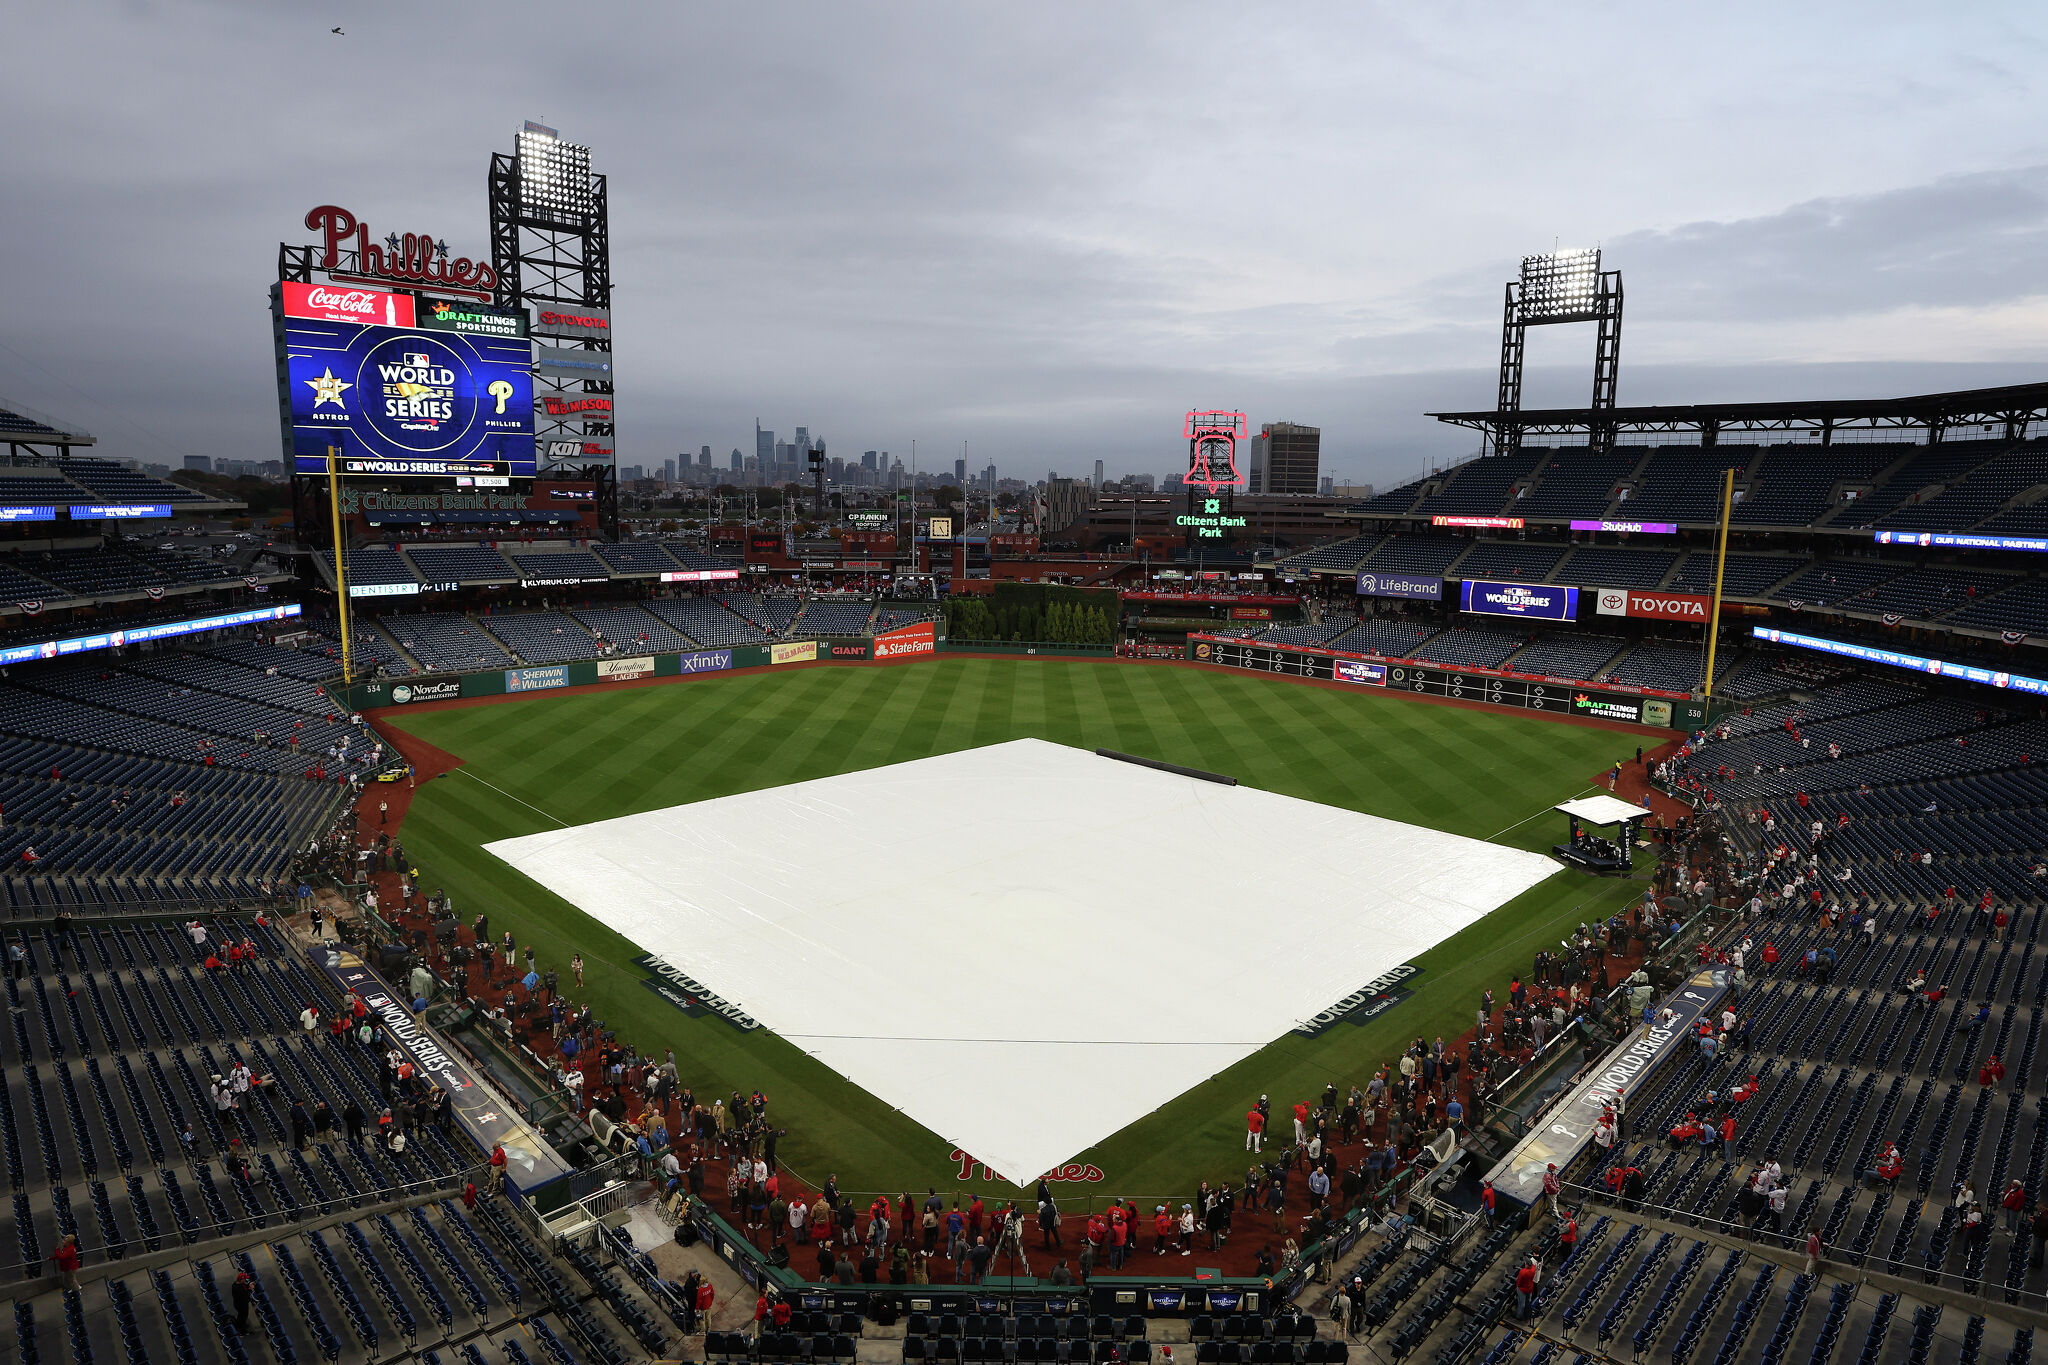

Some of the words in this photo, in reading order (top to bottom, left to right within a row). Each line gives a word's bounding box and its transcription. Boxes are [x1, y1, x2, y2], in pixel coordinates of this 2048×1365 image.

[305, 205, 498, 289] Phillies
[307, 288, 376, 314] Coca-Cola
[456, 322, 516, 334] SPORTSBOOK
[558, 314, 608, 330] TOYOTA
[378, 364, 455, 386] WORLD
[386, 399, 452, 420] SERIES
[312, 413, 350, 421] ASTROS
[548, 442, 582, 456] KDI
[363, 461, 409, 472] WORLD
[410, 462, 447, 472] SERIES
[363, 494, 439, 510] Citizens
[442, 494, 487, 510] Bank
[490, 494, 526, 510] Park
[1176, 515, 1218, 526] Citizens
[1220, 516, 1246, 526] Bank
[1602, 522, 1642, 532] StubHub
[1199, 527, 1222, 537] Park
[1935, 536, 1954, 544] OUR
[1956, 538, 2000, 547] NATIONAL
[2002, 541, 2046, 549] PASTIME
[351, 585, 416, 596] DENTISTRY
[420, 583, 432, 592] for
[434, 583, 458, 592] LIFE
[1380, 580, 1437, 594] LifeBrand
[1486, 593, 1520, 604] WORLD
[1520, 596, 1551, 607] SERIES
[1632, 598, 1705, 616] TOYOTA
[129, 630, 148, 640] OUR
[150, 624, 191, 637] NATIONAL
[832, 647, 866, 655] GIANT
[1782, 634, 1797, 643] OUR
[1798, 637, 1832, 650] NATIONAL
[1866, 650, 1881, 660] ALL
[605, 661, 646, 673] Yuengling
[684, 653, 729, 672] xfinity
[522, 669, 563, 680] SHERWIN
[614, 672, 639, 681] LAGER
[1339, 667, 1362, 676] WORLD
[1362, 670, 1382, 678] SERIES
[366, 684, 381, 693] 334
[412, 682, 460, 696] NovaCare
[522, 678, 564, 689] WILLIAMS
[2015, 679, 2039, 691] OUR
[412, 692, 458, 701] REHABILITATION
[1590, 708, 1637, 720] SPORTSBOOK
[1688, 709, 1701, 718] 330
[642, 955, 704, 993] WORLD
[699, 988, 760, 1030] SERIES
[1296, 992, 1366, 1033] WORLD
[1364, 965, 1416, 996] SERIES
[379, 1002, 414, 1042] WORLD
[406, 1035, 454, 1072] SERIES
[1594, 1053, 1647, 1091] WORLD
[1637, 1025, 1673, 1059] SERIES
